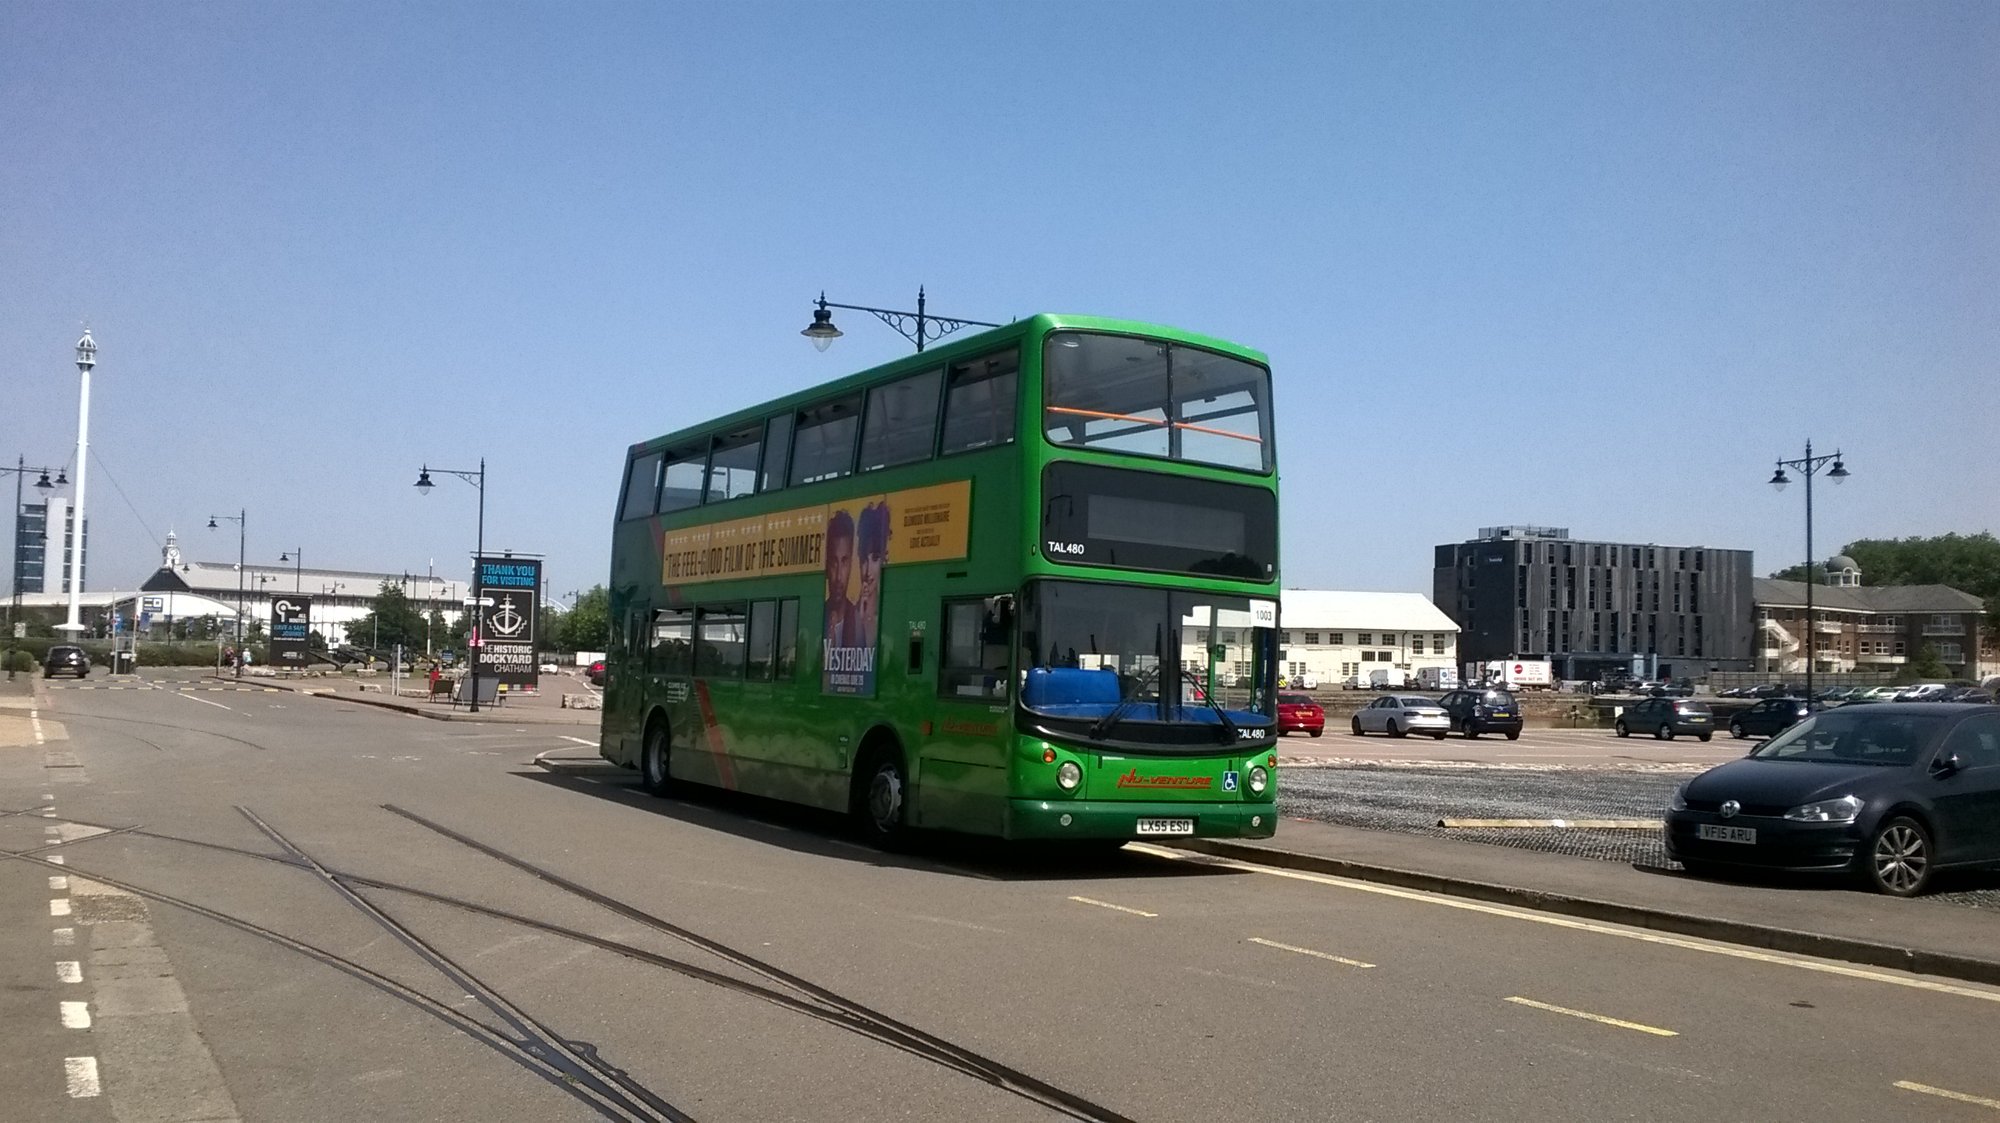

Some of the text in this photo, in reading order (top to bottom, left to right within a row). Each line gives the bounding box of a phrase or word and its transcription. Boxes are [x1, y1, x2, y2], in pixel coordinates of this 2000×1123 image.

[1047, 541, 1085, 555] TAL480
[681, 546, 722, 577] FEEL-GOOD
[723, 544, 744, 573] FILM
[744, 543, 756, 571] OF
[759, 538, 776, 569] THE
[482, 564, 535, 577] THANK YOU
[481, 575, 535, 587] FOR VISITING
[1256, 610, 1272, 621] 1003
[494, 645, 533, 654] HISTORIC
[823, 638, 876, 672] YESTERDAY
[480, 654, 533, 664] DOCKYARD
[493, 663, 532, 673] CHATHAM
[1141, 820, 1167, 832] LX55
[1704, 825, 1752, 842] VF15 ARU
